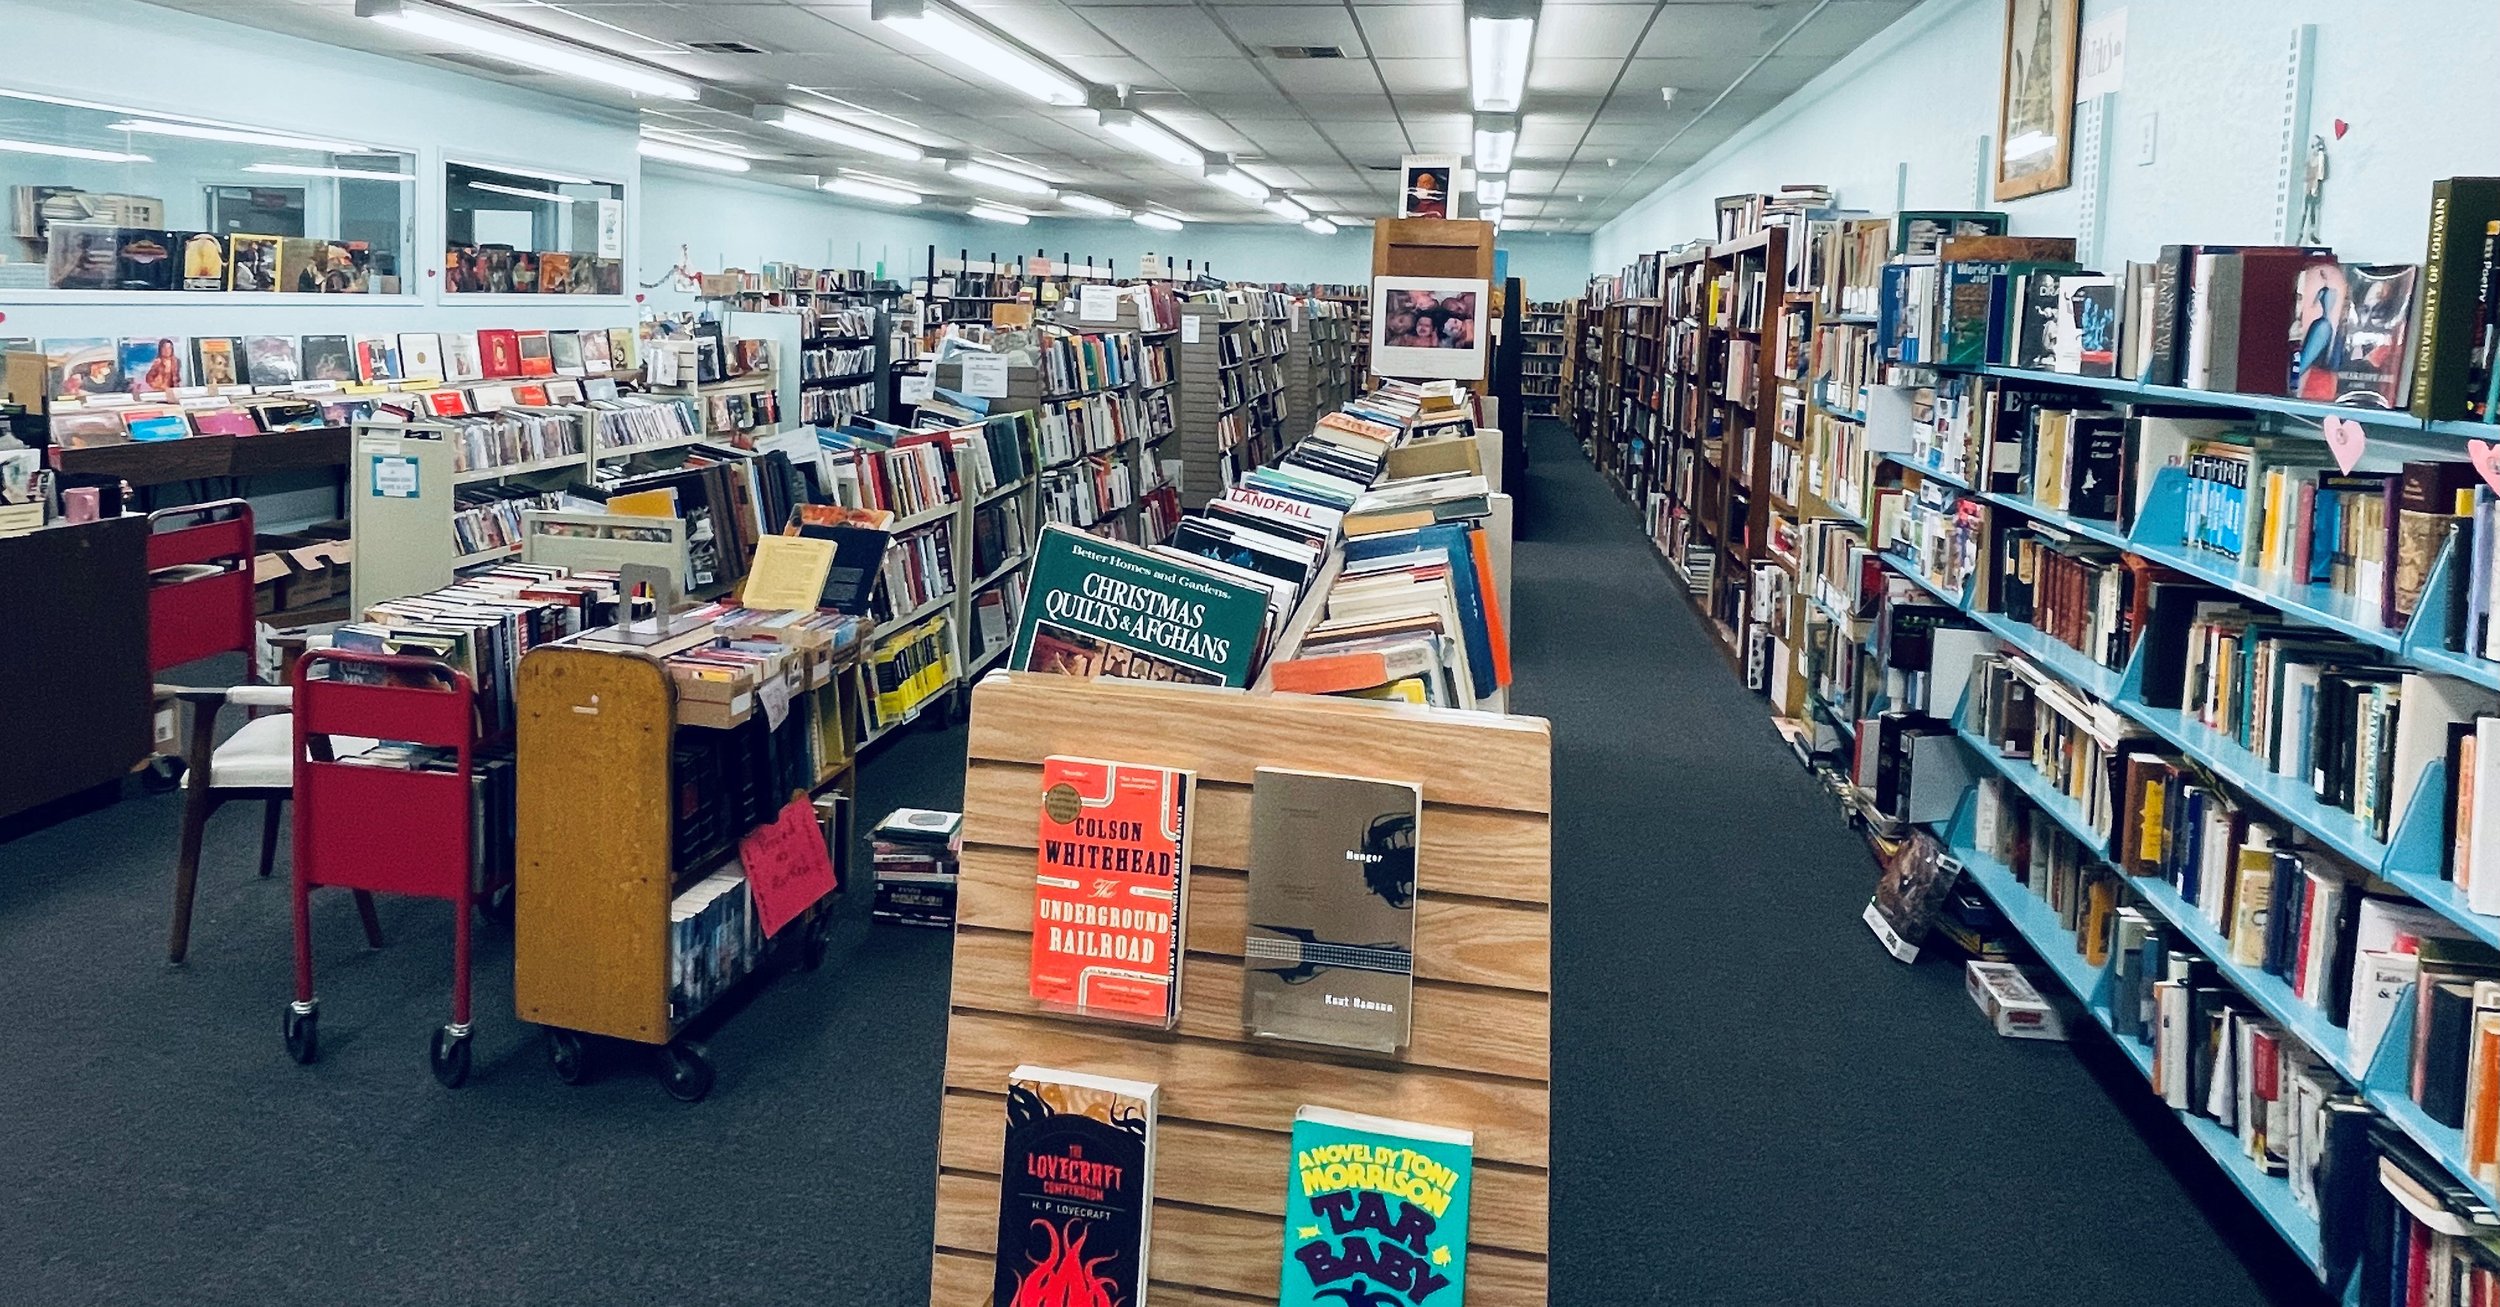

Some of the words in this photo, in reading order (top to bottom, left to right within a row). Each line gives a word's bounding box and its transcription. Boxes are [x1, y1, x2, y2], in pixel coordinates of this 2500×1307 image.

[2431, 198, 2446, 260] LOUVAIN
[2428, 263, 2440, 281] OF
[2420, 287, 2437, 373] UNIVERSITY
[1231, 488, 1312, 519] LANDFALL
[1071, 544, 1109, 564] Better
[1109, 555, 1151, 575] Homes
[1153, 567, 1177, 584] and
[1083, 572, 1206, 629] CHRISTMAS
[1045, 589, 1121, 631] QUILTS
[1119, 615, 1133, 631] &
[1128, 614, 1231, 664] AFGHANS
[1075, 817, 1142, 842] COLSON
[1045, 839, 1171, 876] WHITEHEAD
[1345, 850, 1383, 864] Hunger
[1087, 878, 1120, 898] The
[1040, 898, 1169, 934] UNDERGROUND
[1049, 926, 1155, 964] RAILROAD
[1324, 994, 1349, 1008] Knut
[1353, 997, 1394, 1013] Hamsun
[1027, 1153, 1123, 1192] LOVECRAFT
[1299, 1151, 1313, 1170] A
[1311, 1144, 1374, 1165] NOVEL
[1375, 1147, 1402, 1168] BY
[1401, 1149, 1459, 1192] TONI
[1043, 1182, 1104, 1201] COMPENDIUM
[1300, 1163, 1453, 1219] MORRISON
[1057, 1205, 1112, 1221] LOVECRAFT
[1310, 1190, 1437, 1256] TAR
[1294, 1236, 1452, 1306] BABY
